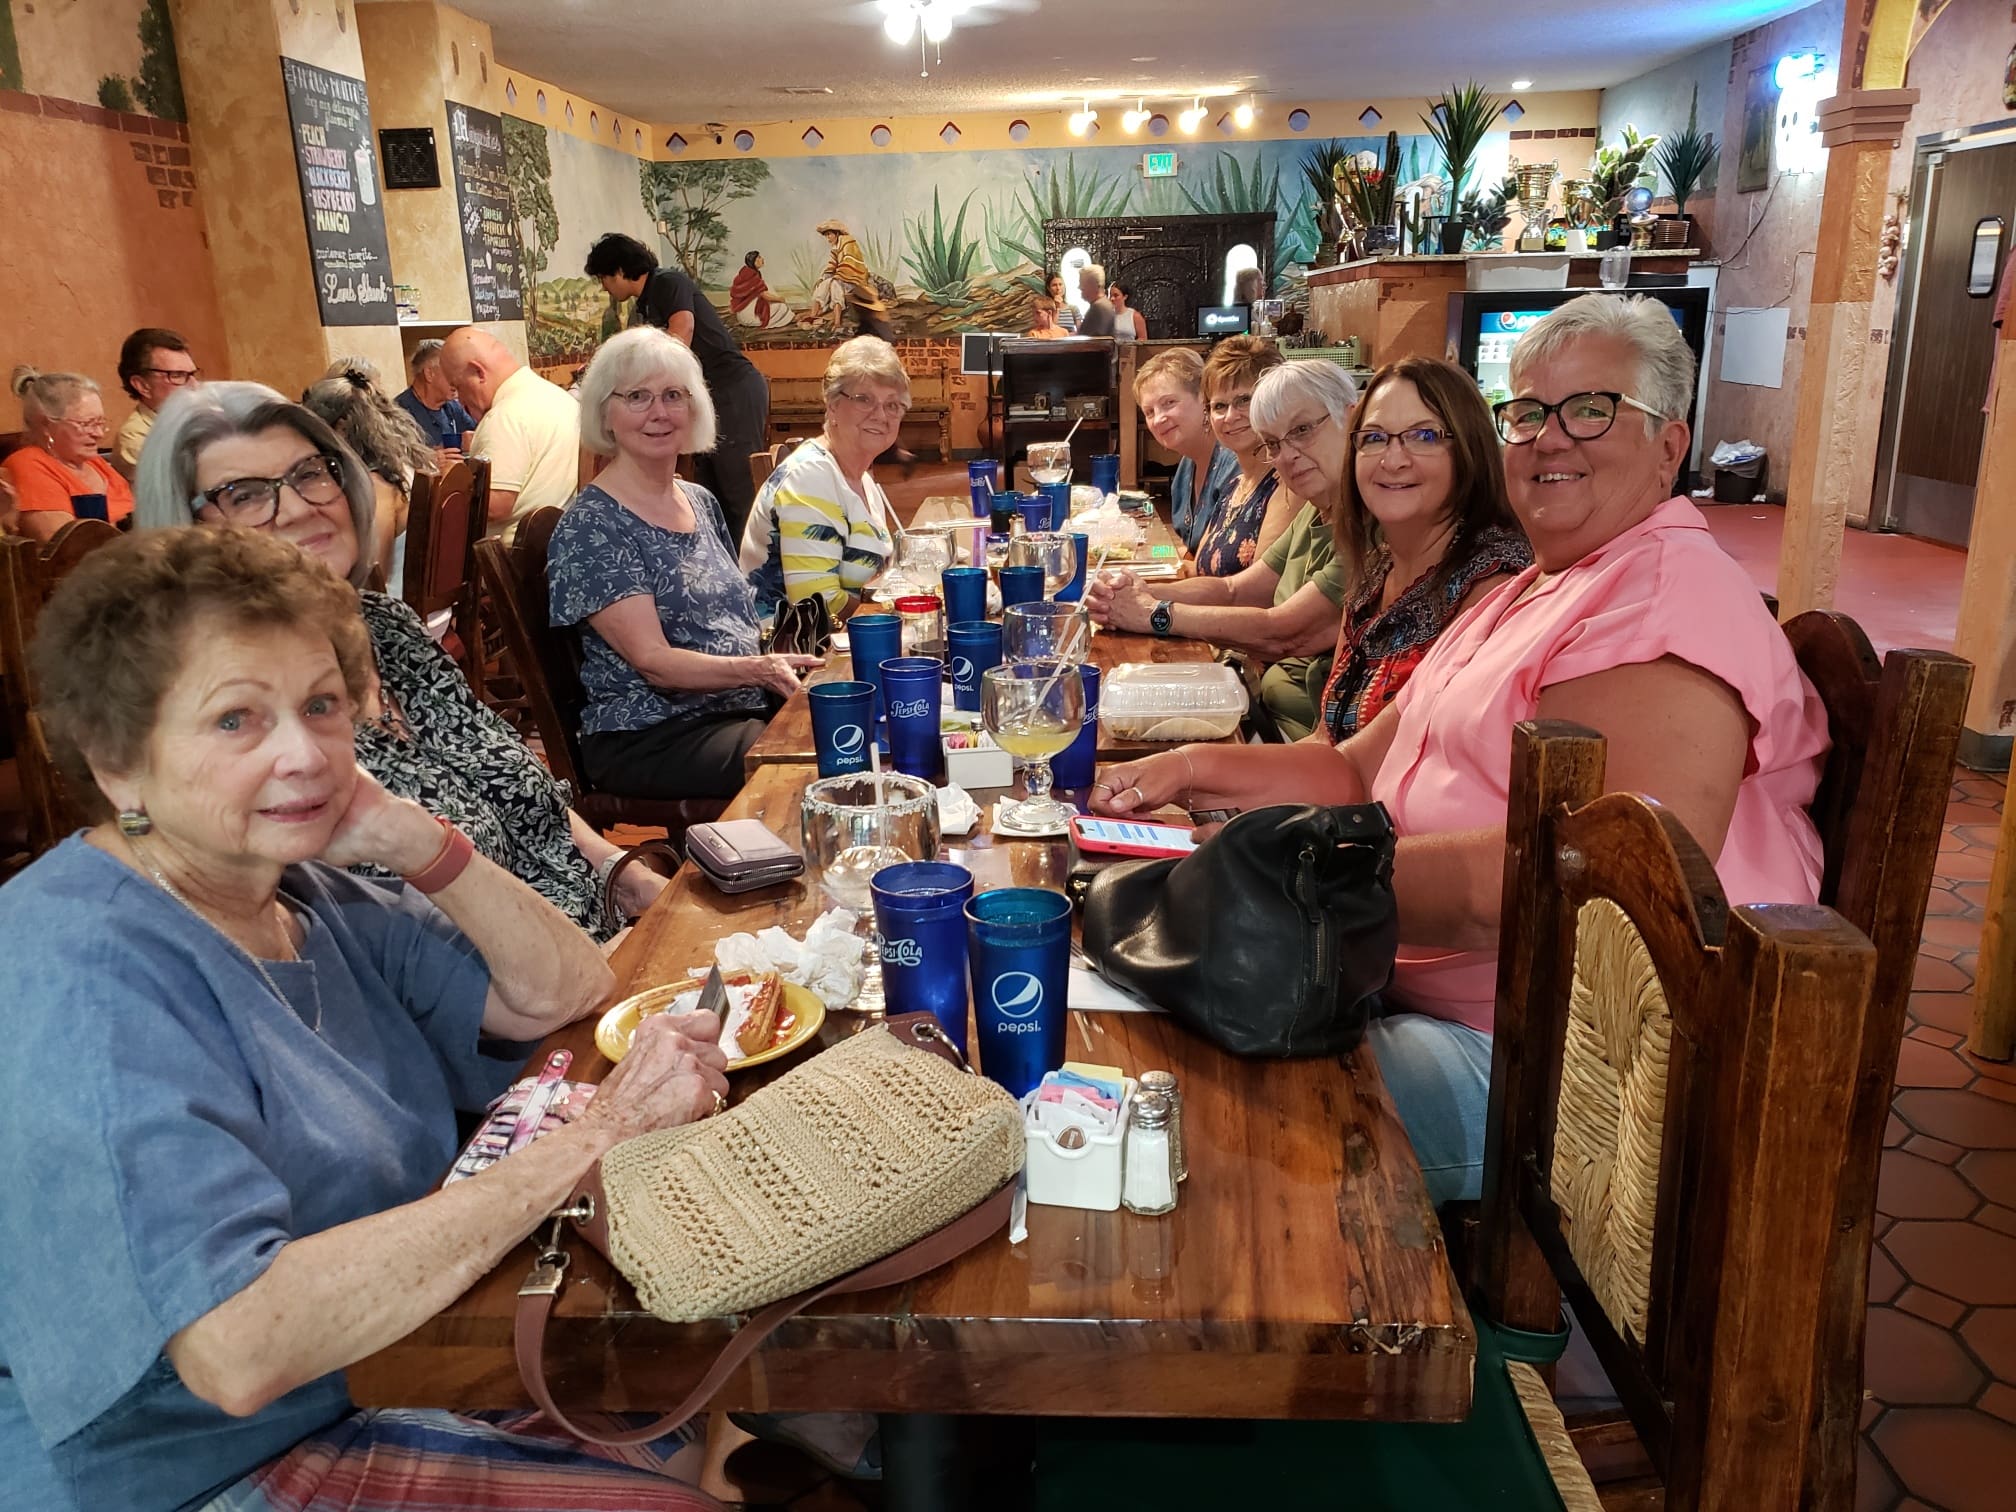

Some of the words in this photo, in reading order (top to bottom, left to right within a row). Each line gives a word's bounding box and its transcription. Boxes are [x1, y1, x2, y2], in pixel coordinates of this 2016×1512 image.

[301, 123, 327, 147] PEACH
[311, 189, 356, 212] RASPBERRY
[315, 209, 350, 234] MANGO
[836, 755, 864, 766] pepsi
[997, 1020, 1038, 1035] pepsi
